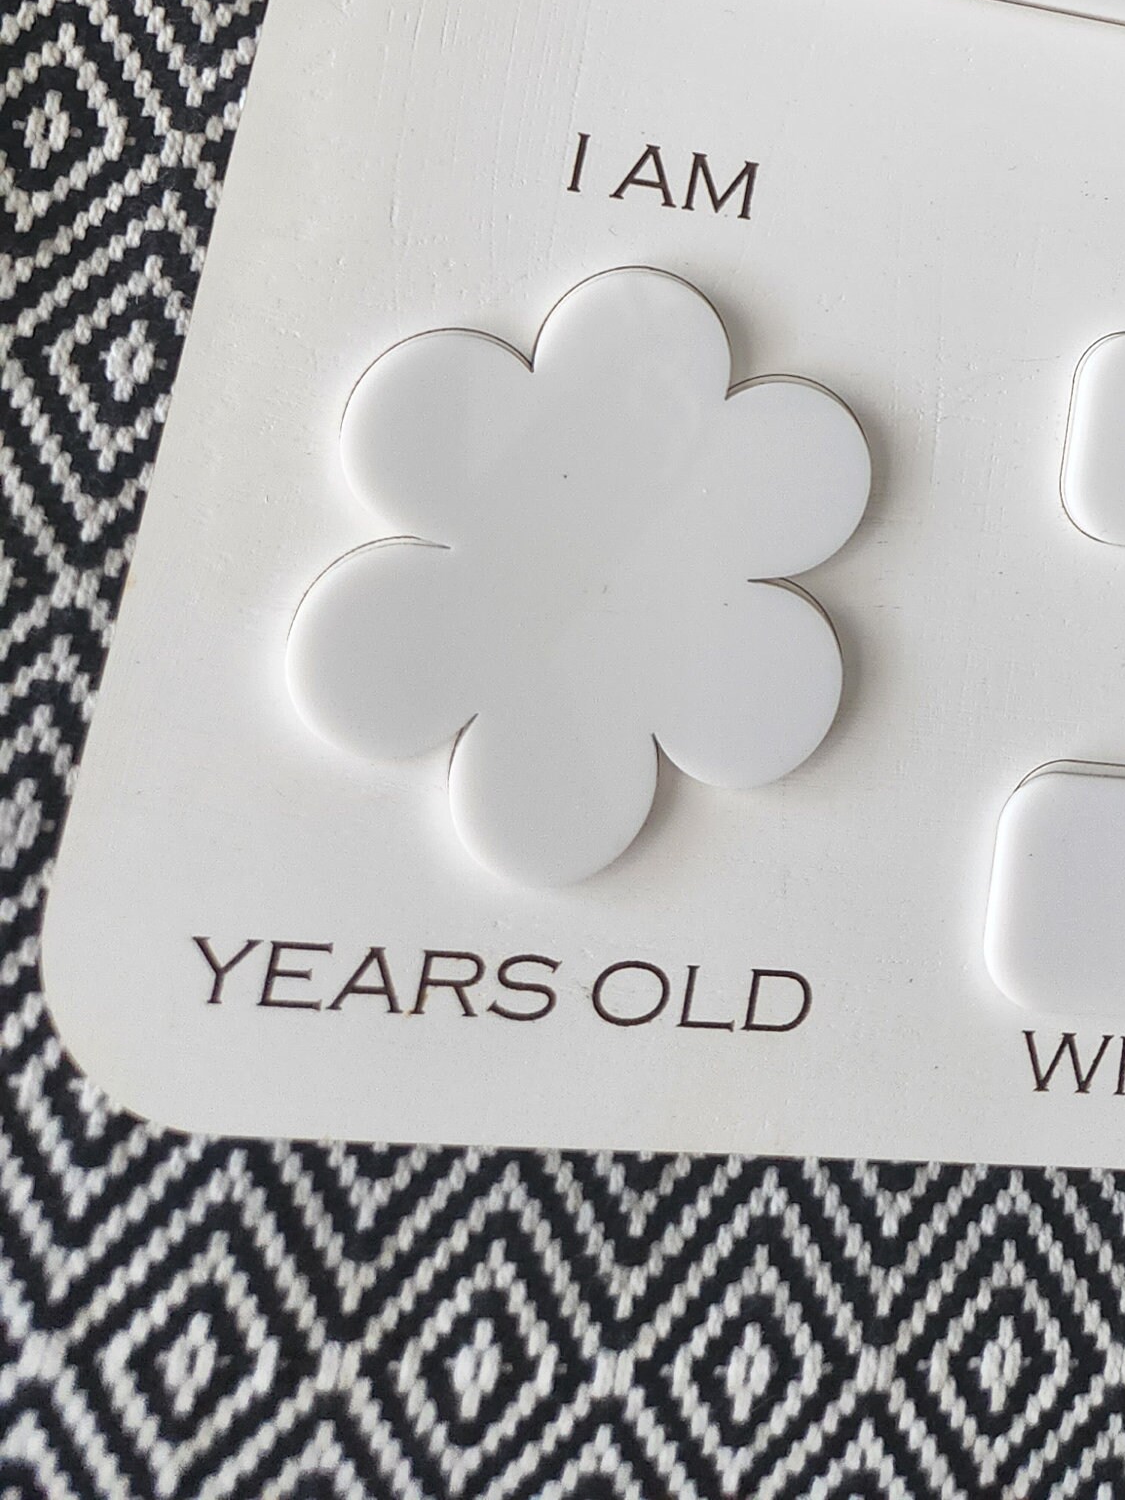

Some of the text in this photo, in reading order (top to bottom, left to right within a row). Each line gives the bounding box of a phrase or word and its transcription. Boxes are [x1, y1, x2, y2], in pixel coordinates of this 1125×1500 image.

[566, 132, 760, 220] I AM
[192, 936, 812, 1033] YEARS OLD
